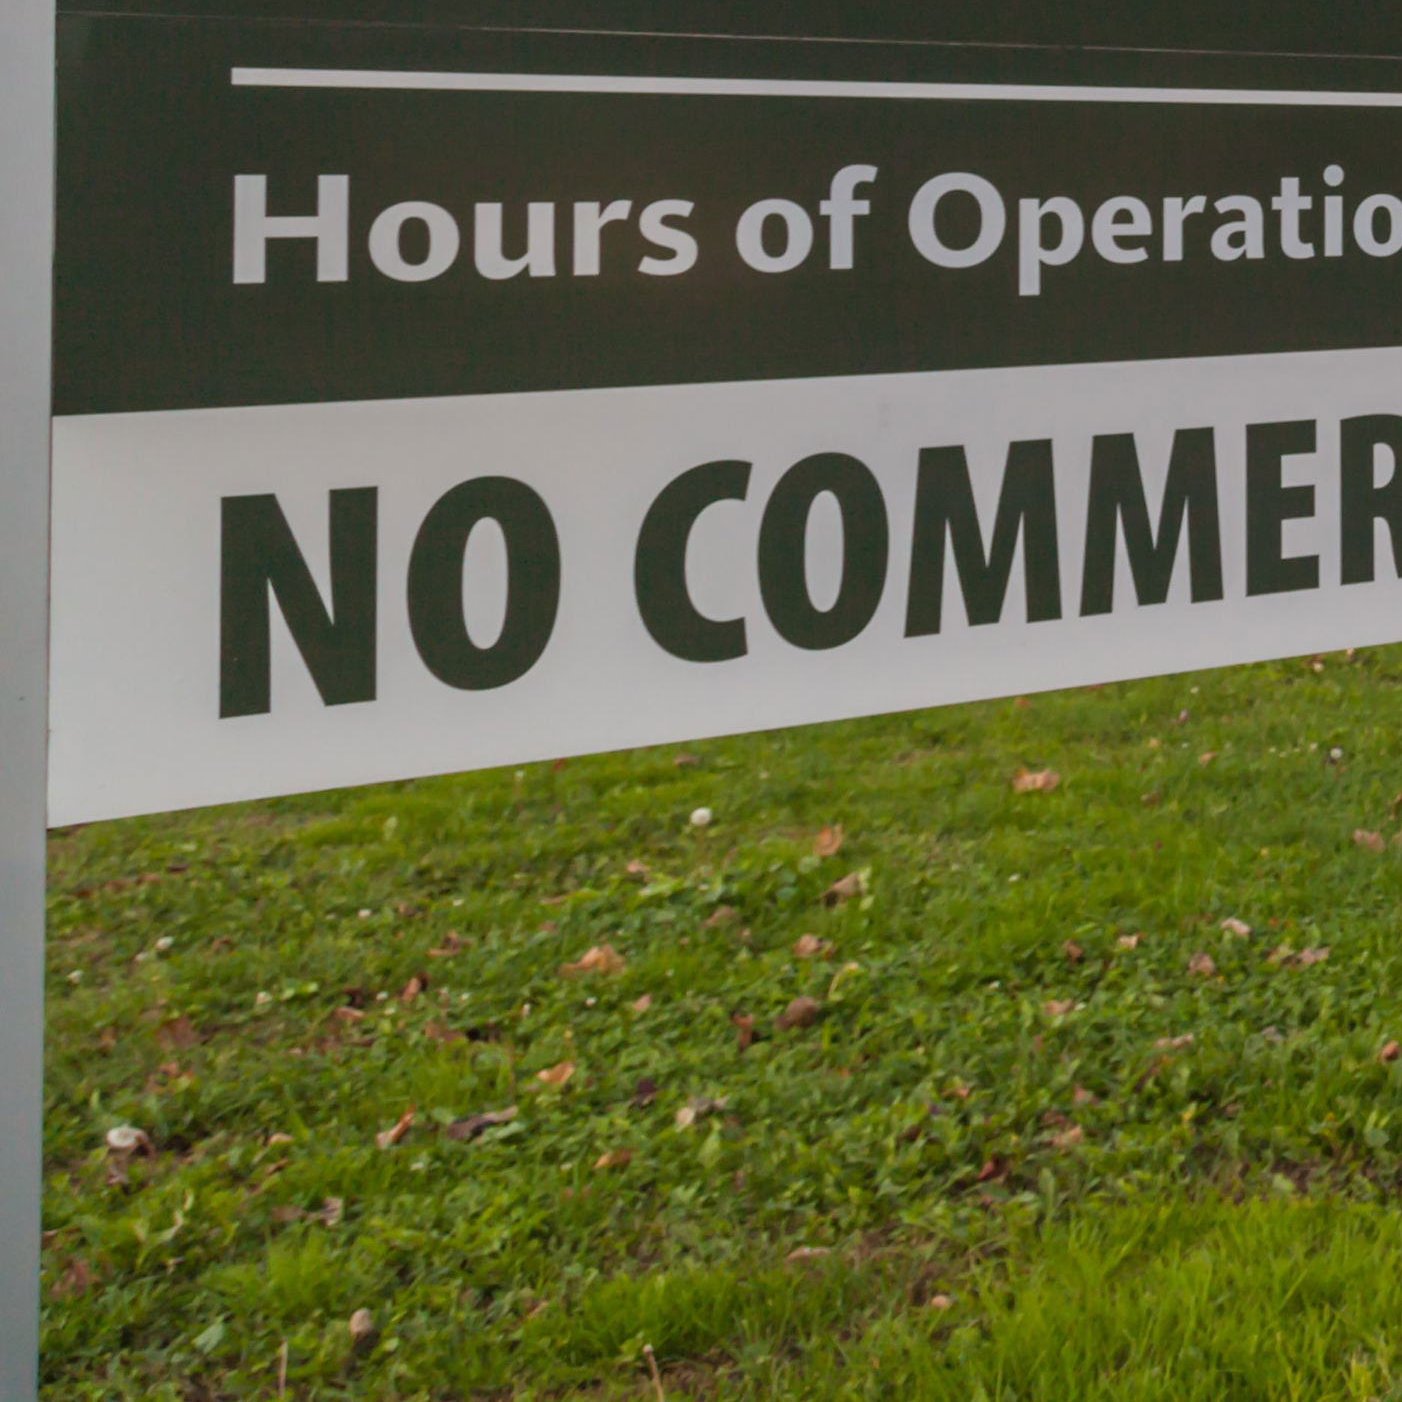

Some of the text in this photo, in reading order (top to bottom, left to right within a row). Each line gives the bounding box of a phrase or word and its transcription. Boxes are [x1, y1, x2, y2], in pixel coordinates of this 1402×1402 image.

[233, 174, 698, 284] Hours
[736, 164, 878, 273] of
[218, 474, 562, 720] NO
